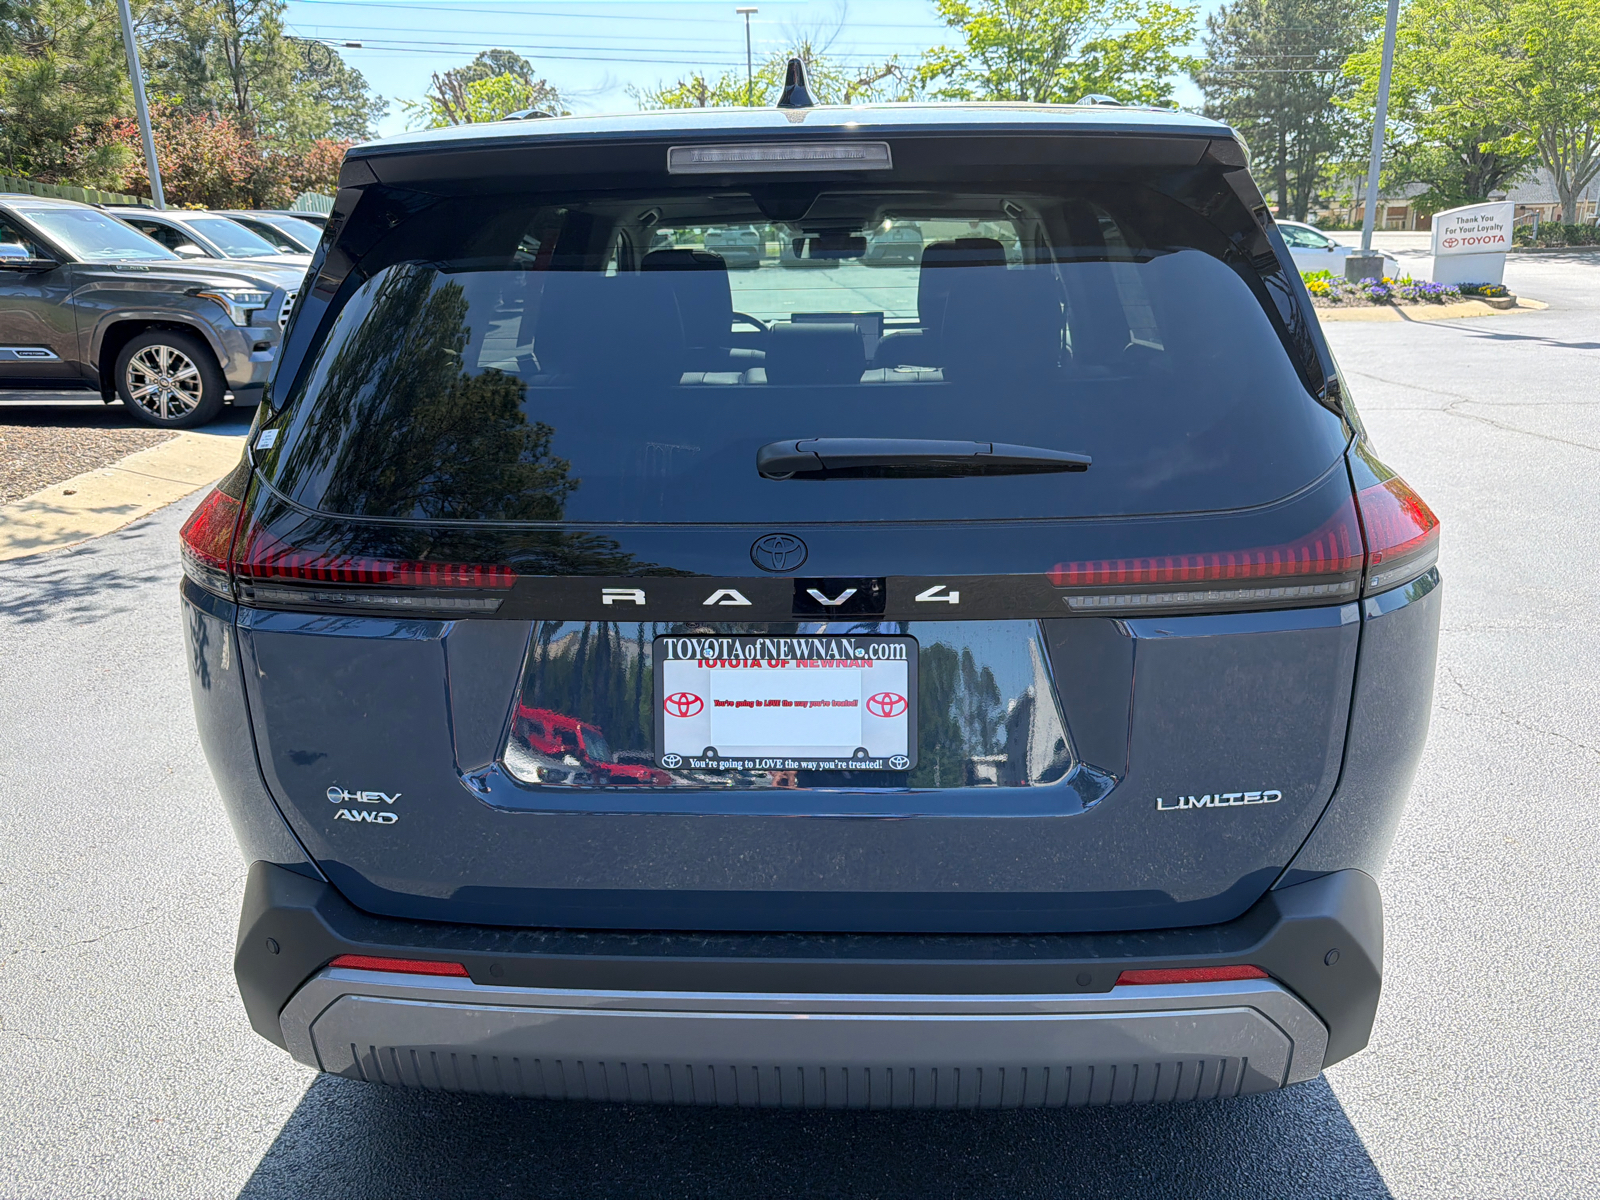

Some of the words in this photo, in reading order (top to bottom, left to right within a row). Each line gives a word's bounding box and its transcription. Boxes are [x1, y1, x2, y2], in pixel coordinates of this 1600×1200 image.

[1456, 215, 1478, 224] Thank
[1445, 227, 1457, 235] For
[1459, 225, 1475, 233] Your
[1477, 223, 1503, 233] Loyalty
[1461, 235, 1505, 246] TOYOTA
[602, 585, 960, 606] RAV4
[735, 700, 754, 708] going
[809, 700, 831, 708] you're
[719, 760, 743, 770] going
[745, 760, 753, 768] to
[755, 759, 783, 768] LOVE
[785, 759, 799, 768] the
[801, 761, 817, 770] way
[849, 760, 883, 769] treated!
[343, 790, 402, 804] HEV
[1157, 789, 1282, 811] LIMITED
[333, 809, 399, 824] AWD
